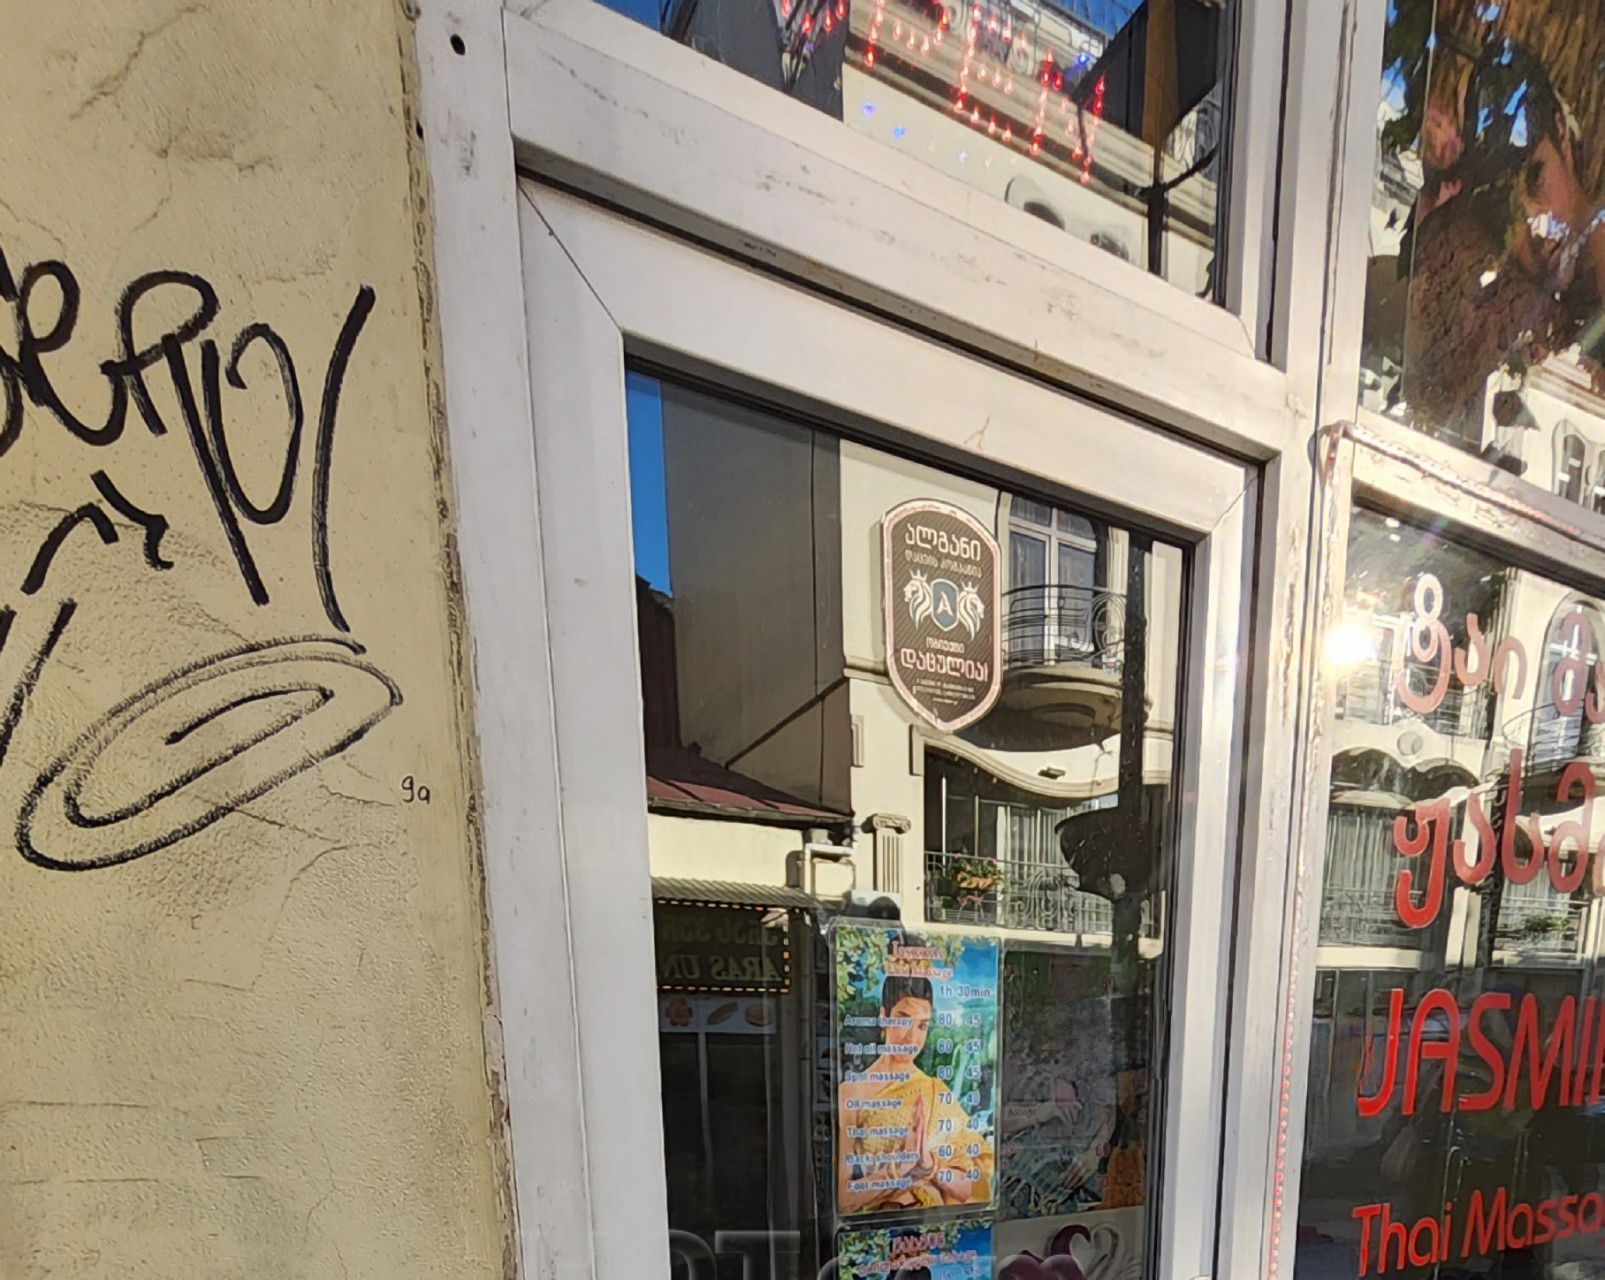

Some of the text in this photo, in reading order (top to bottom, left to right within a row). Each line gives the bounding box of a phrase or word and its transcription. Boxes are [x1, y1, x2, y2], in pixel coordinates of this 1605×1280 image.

[904, 523, 981, 562] ალგანი
[936, 591, 954, 617] A
[938, 1092, 953, 1105] 70
[938, 1119, 953, 1132] 70
[1352, 1201, 1453, 1277] Thai
